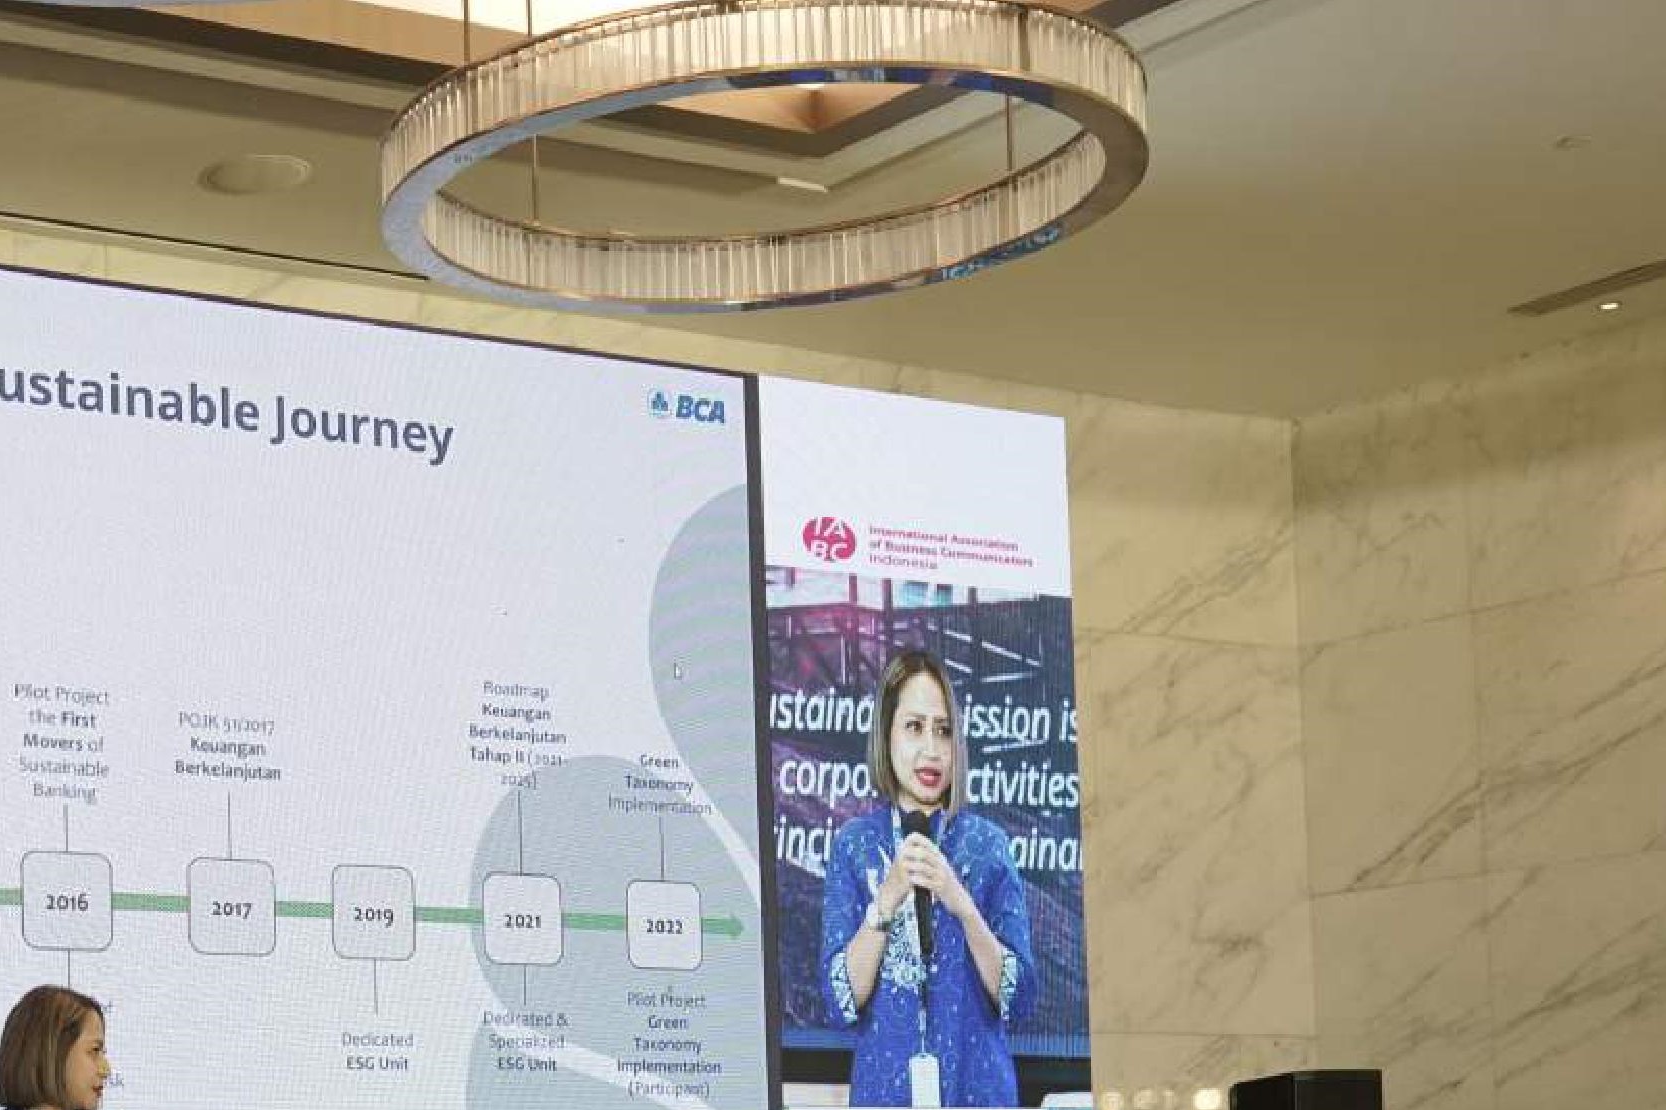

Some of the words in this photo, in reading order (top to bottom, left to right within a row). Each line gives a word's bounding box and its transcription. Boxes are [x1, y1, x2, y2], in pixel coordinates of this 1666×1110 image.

[675, 395, 726, 424] BCA
[270, 395, 454, 467] Journey
[56, 686, 109, 707] Project
[61, 711, 96, 729] First
[481, 703, 552, 723] Keuangan
[23, 733, 82, 752] Movers
[469, 723, 567, 744] Berkelanjutan
[190, 736, 267, 759] Keuangan
[19, 756, 110, 778] Sustainable
[640, 754, 679, 768] Green
[175, 760, 281, 782] Berkelanjutan
[33, 783, 96, 805] Banking
[45, 893, 89, 912] 2016
[211, 902, 252, 920] 2017
[353, 907, 394, 927] 2019
[504, 914, 542, 929] 2021
[645, 920, 684, 935] 2022
[483, 1010, 553, 1027] Dedicated
[556, 1013, 569, 1027] &
[648, 1015, 689, 1029] Green
[342, 1032, 414, 1047] Dedicated
[634, 1037, 701, 1056] Taxonomy
[346, 1056, 375, 1070] ESG
[379, 1056, 408, 1070] Unit
[498, 1056, 525, 1070] ESG
[527, 1057, 557, 1071] Unit
[617, 1058, 722, 1078] Implementation
